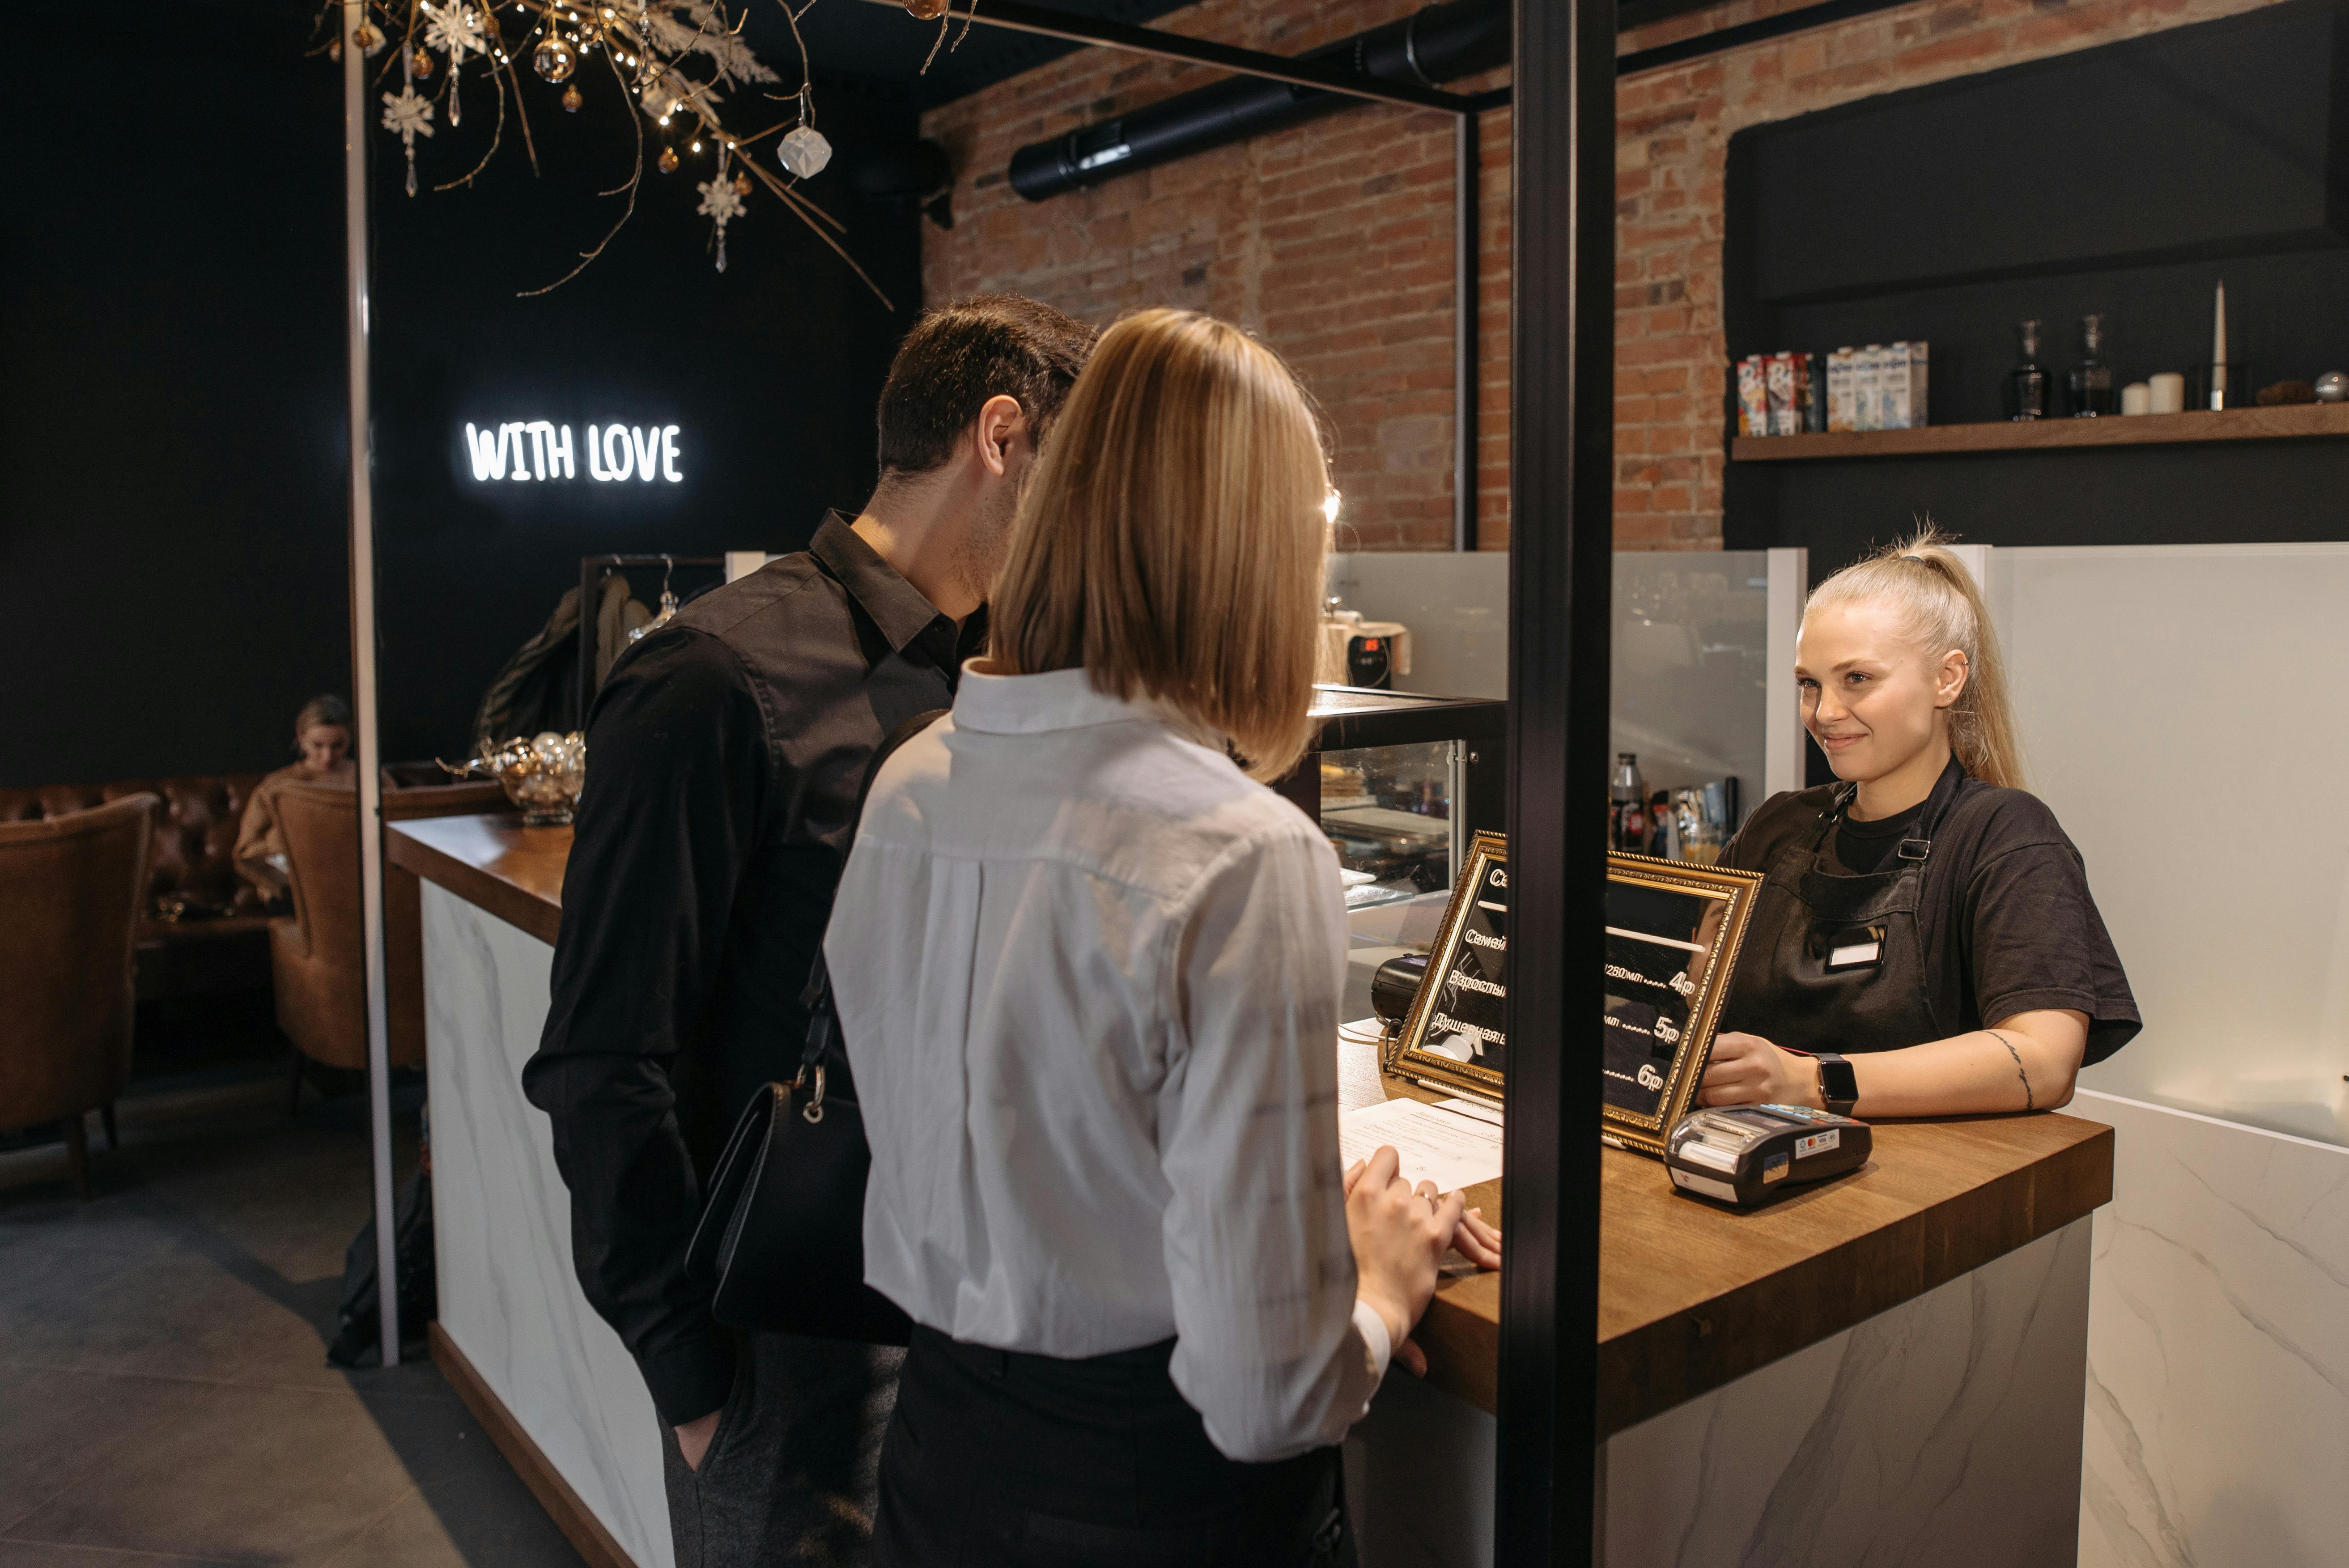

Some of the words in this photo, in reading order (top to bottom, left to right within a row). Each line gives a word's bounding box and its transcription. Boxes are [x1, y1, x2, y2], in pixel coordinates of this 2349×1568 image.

[466, 421, 575, 481] WITH
[589, 424, 683, 482] LOVE
[1490, 868, 1507, 888] Се
[1465, 929, 1507, 951] Семей
[1654, 1016, 1679, 1044] 5р
[1431, 1012, 1501, 1043] Душевная
[1637, 1064, 1663, 1092] 6р
